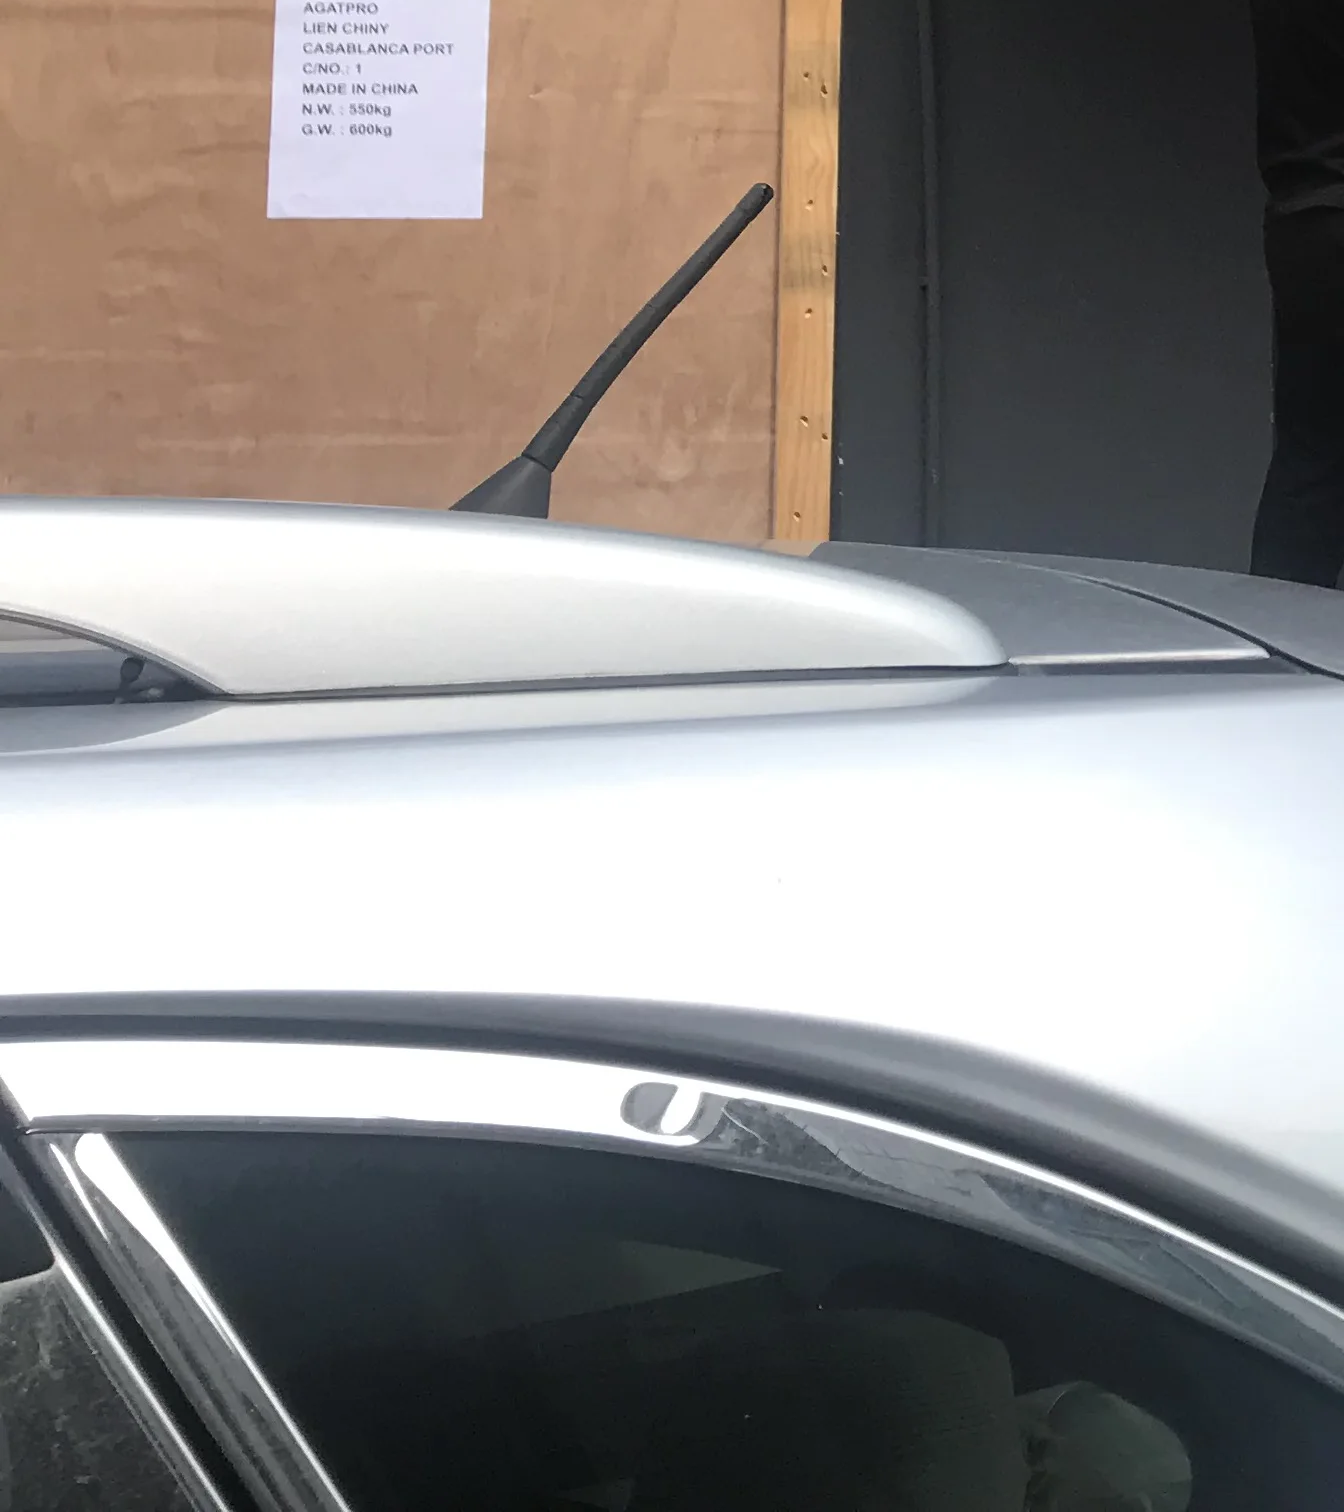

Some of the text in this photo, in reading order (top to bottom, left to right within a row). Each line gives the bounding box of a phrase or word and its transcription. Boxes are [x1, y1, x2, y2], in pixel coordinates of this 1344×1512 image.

[303, 1, 379, 15] AGATPRO
[302, 21, 389, 35] LIEN CHINY
[302, 42, 454, 56] CASABLANCA PORT
[302, 82, 419, 96] MADE IN CHINA
[348, 102, 393, 118] 550kg
[348, 122, 393, 138] 600kg
